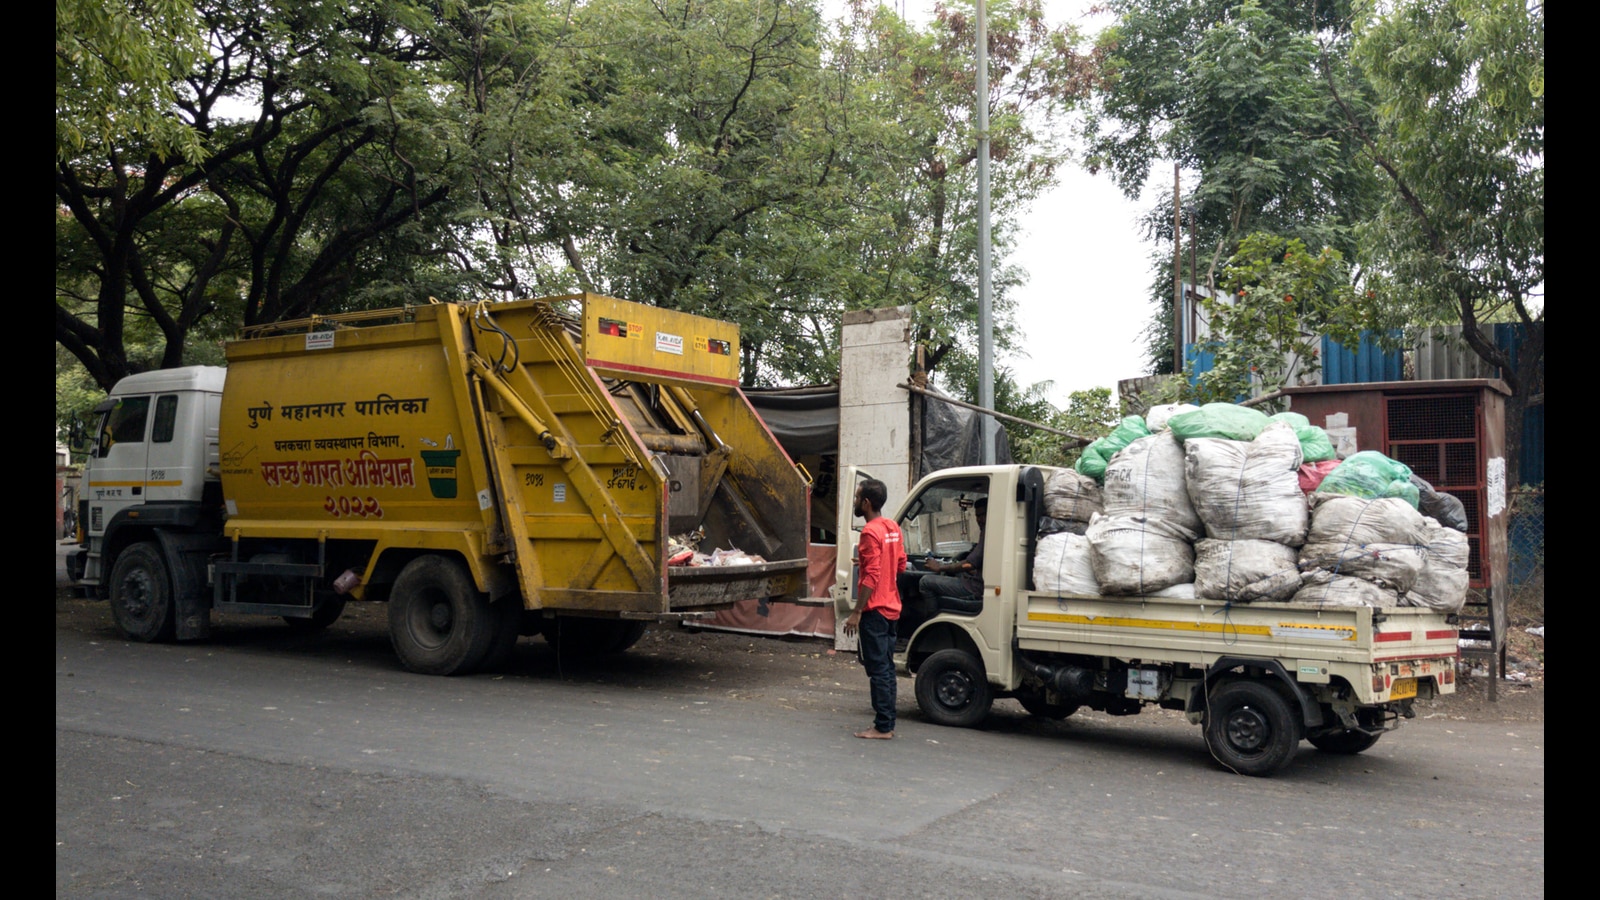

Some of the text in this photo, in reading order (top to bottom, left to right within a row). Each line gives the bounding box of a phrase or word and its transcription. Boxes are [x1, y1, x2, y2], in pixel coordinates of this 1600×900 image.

[628, 323, 642, 332] STOP
[248, 393, 429, 429] पुणे महानगर पालिका
[274, 439, 311, 452] घनकचरा
[314, 437, 364, 451] व्यवस्थापन
[261, 450, 415, 488] स्वच्छ भारत अभियान
[324, 496, 383, 518] २०२२
